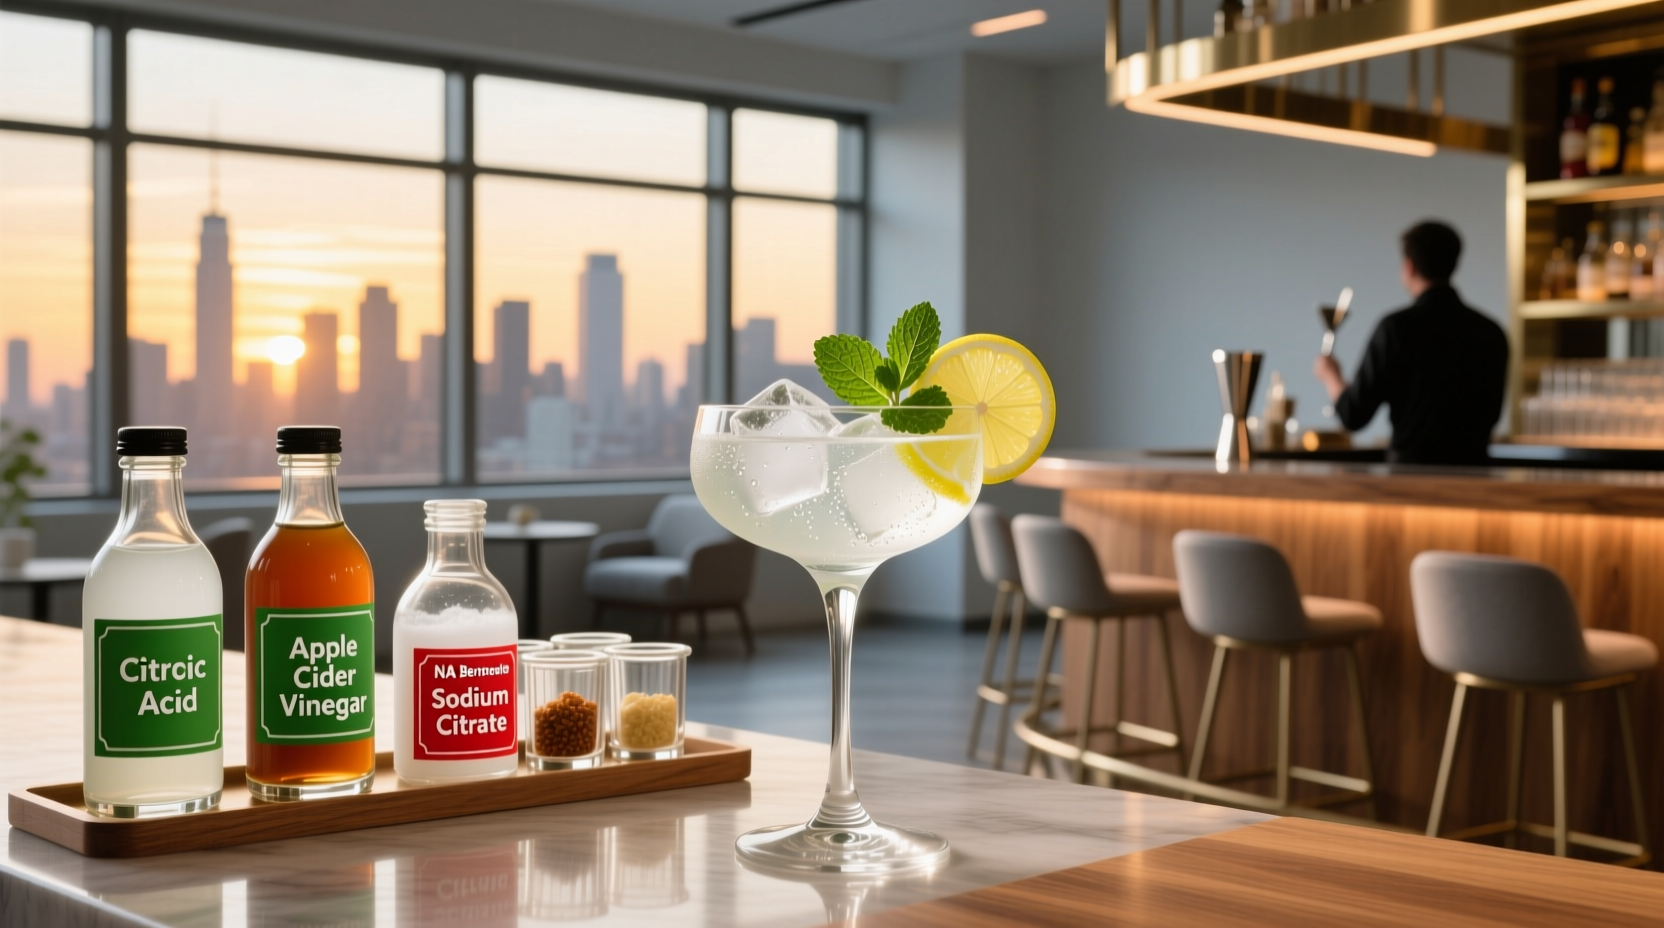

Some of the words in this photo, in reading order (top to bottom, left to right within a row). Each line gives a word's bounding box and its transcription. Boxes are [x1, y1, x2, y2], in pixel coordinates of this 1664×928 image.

[289, 633, 358, 665] Apple
[293, 664, 357, 689] Cider
[434, 664, 457, 679] NA
[137, 686, 198, 716] Acid
[279, 693, 368, 721] Vinegar
[431, 686, 509, 709] Sodium
[436, 714, 508, 736] Citrate
